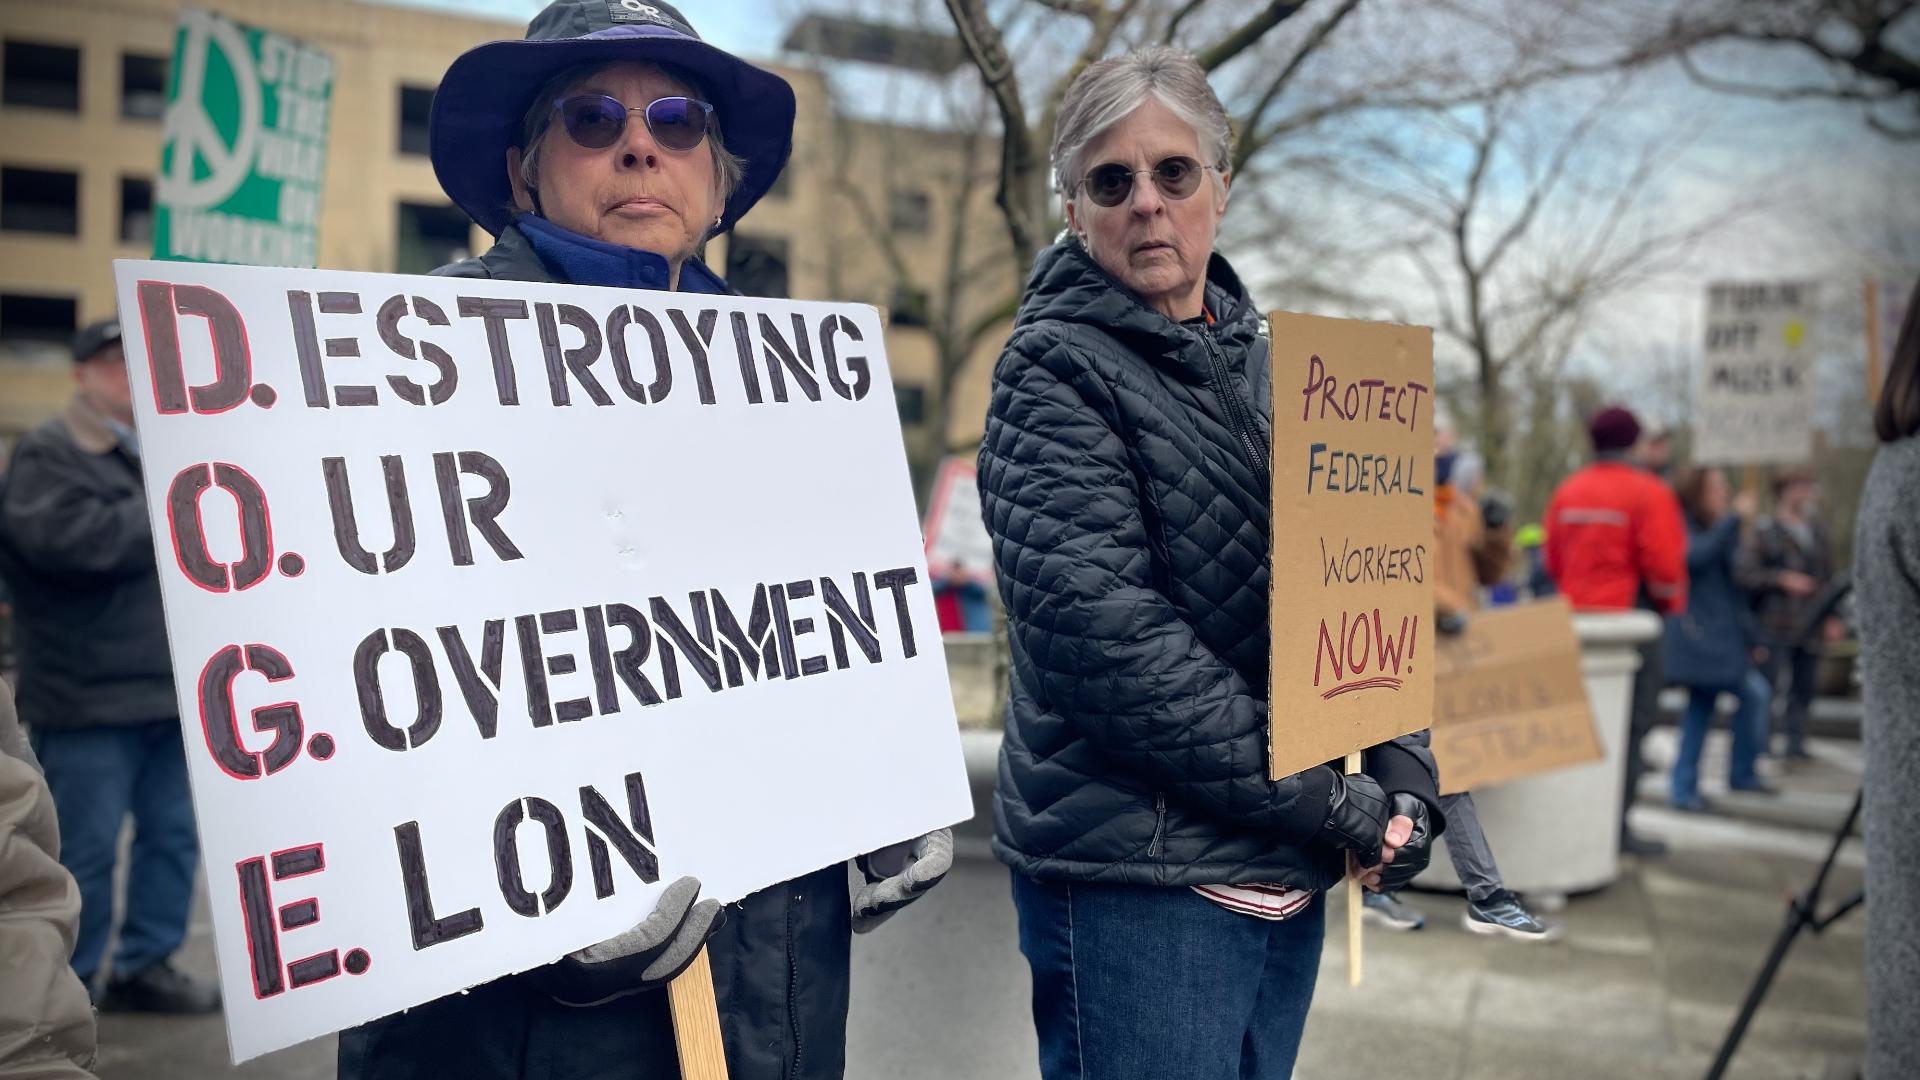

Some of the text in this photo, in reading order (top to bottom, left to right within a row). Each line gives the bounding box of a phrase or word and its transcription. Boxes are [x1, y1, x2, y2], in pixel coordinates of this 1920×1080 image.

[1302, 354, 1428, 432] PROTECT
[1307, 443, 1424, 496] FEDERAL
[1320, 537, 1426, 587] WORKERS
[1314, 608, 1418, 687] NOW!
